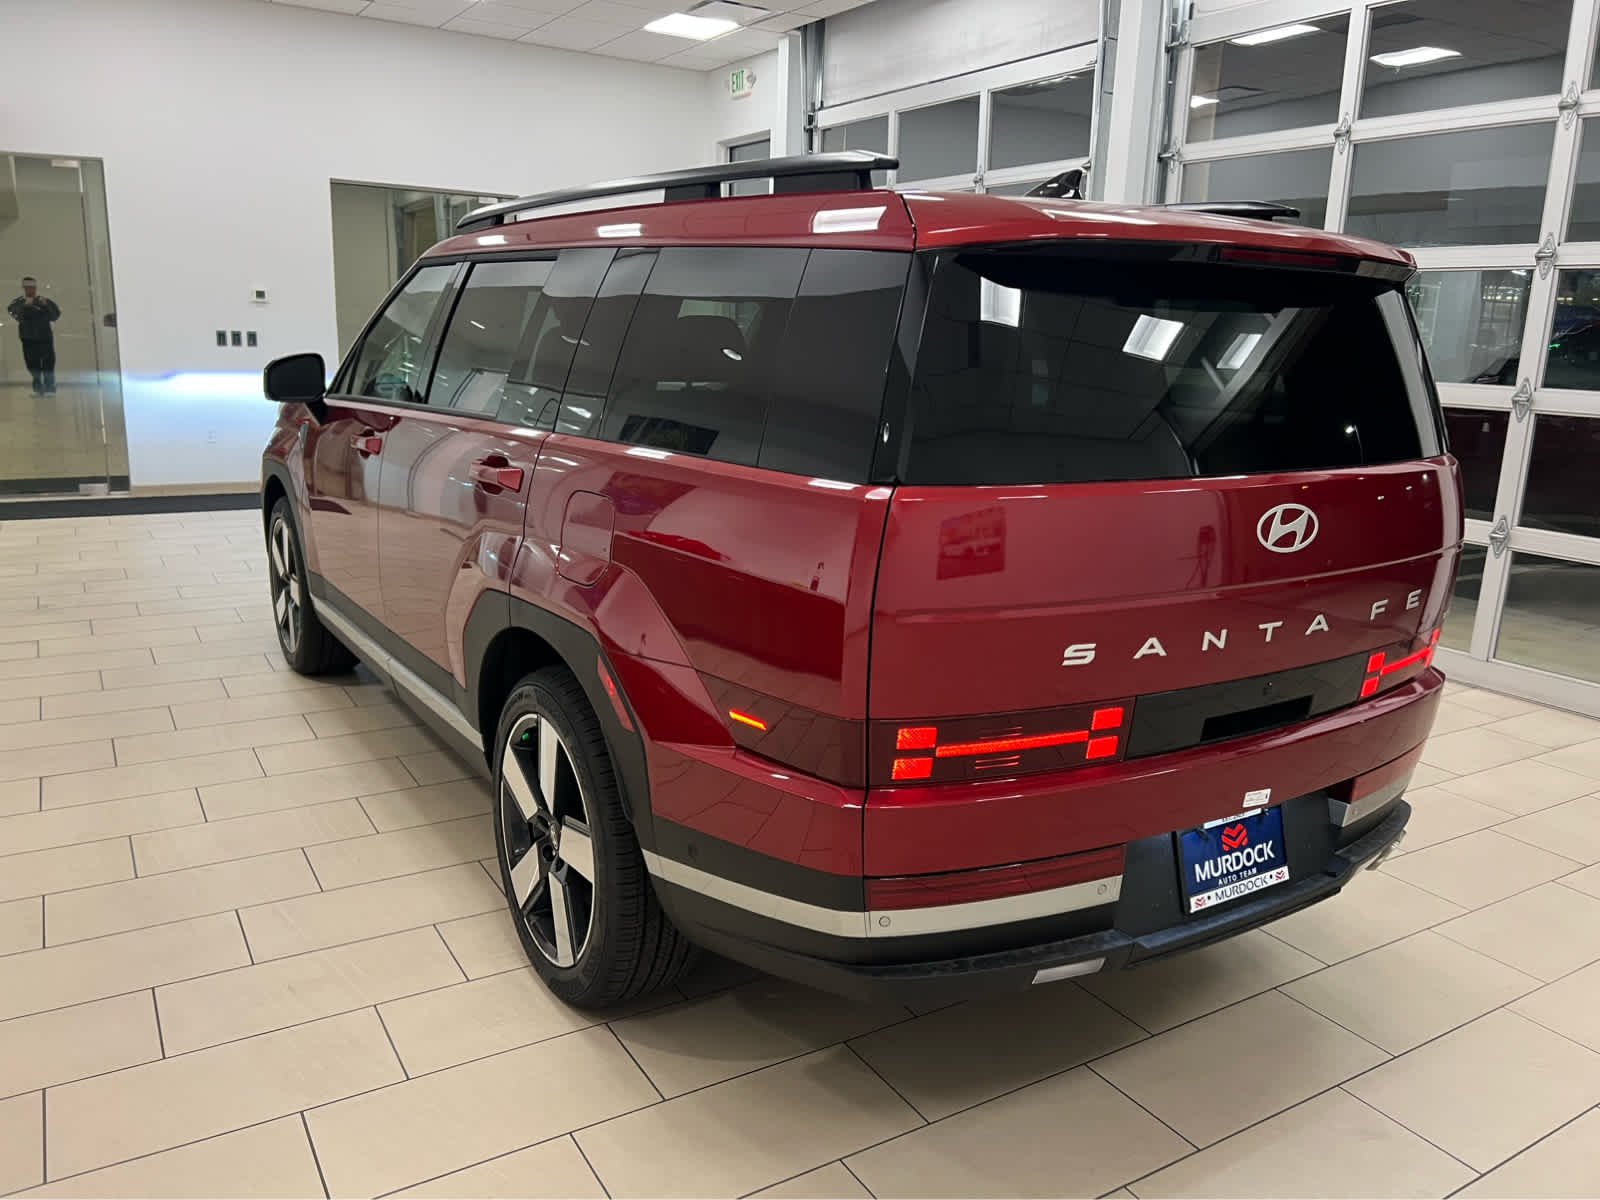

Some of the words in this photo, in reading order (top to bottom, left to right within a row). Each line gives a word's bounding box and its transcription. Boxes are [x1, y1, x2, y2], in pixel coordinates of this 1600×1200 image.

[731, 70, 745, 93] EXIT
[1062, 614, 1329, 666] SANTA
[1370, 589, 1422, 620] FE
[1194, 840, 1275, 883] MURDOCK
[1215, 875, 1269, 901] MURDOCK
[1218, 874, 1238, 887] AUTO
[1239, 867, 1257, 879] TEAM
